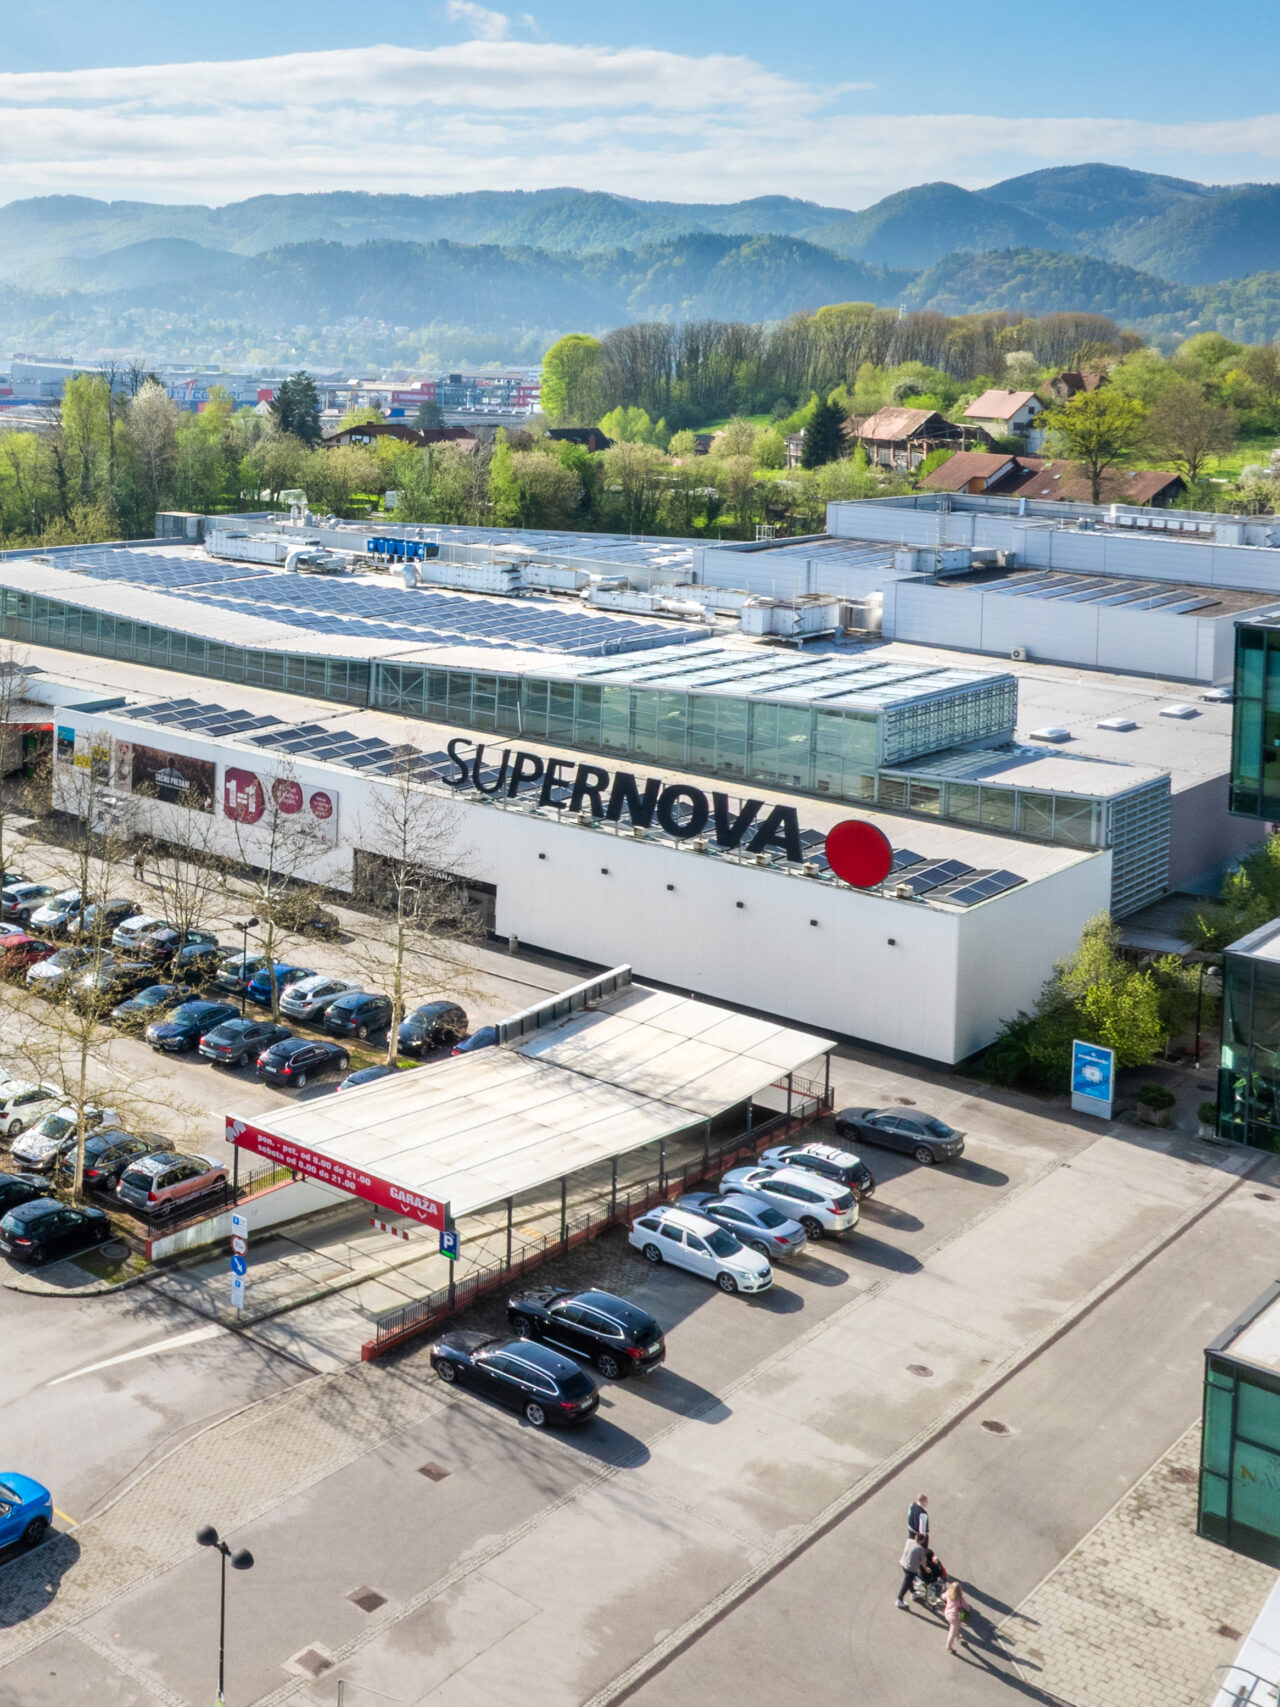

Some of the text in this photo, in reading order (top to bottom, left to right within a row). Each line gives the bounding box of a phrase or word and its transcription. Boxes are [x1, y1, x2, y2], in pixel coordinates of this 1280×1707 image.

[442, 738, 803, 863] SUPERNOVA
[257, 1134, 275, 1147] pon.
[300, 1151, 311, 1161] od
[313, 1157, 331, 1169] 8.00
[333, 1164, 344, 1175] do
[346, 1170, 371, 1186] 21.00
[257, 1145, 356, 1190] sobota od 8.00 do 21.00
[389, 1186, 438, 1216] GARAŽA
[443, 1234, 454, 1249] P
